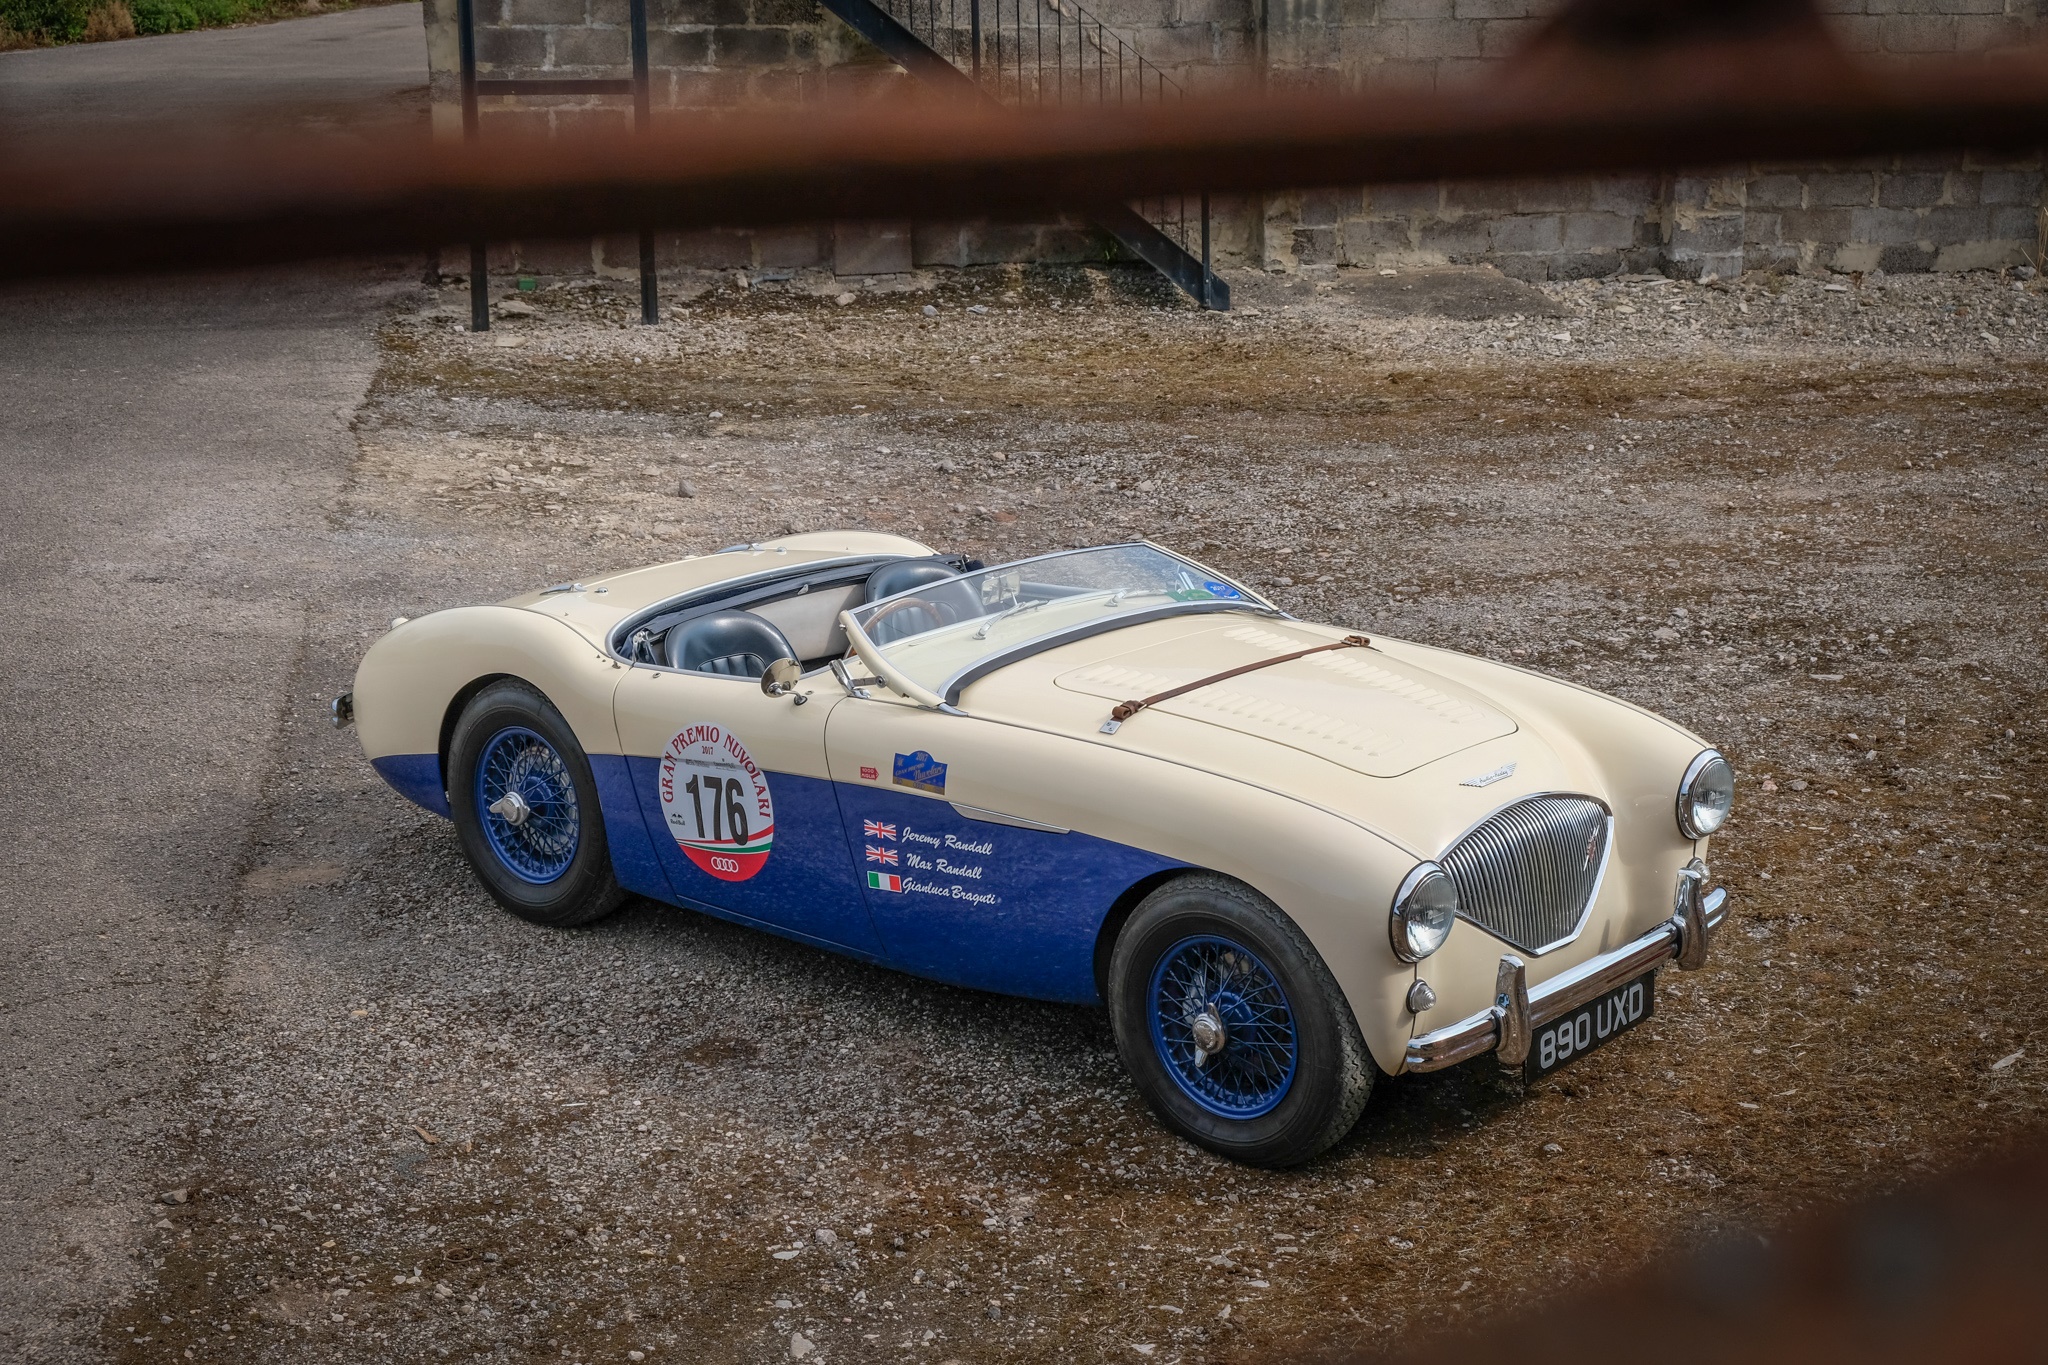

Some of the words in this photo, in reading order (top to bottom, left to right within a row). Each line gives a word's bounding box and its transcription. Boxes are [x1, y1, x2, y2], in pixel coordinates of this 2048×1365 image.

[701, 746, 714, 755] 2017
[661, 751, 678, 803] GRAN
[671, 725, 720, 755] PREMIO
[723, 734, 771, 818] NUVOLARI
[686, 774, 749, 846] 176
[902, 826, 941, 849] Jeremy
[944, 834, 993, 855] Randall
[906, 853, 933, 870] Max
[936, 858, 983, 879] Randall
[902, 877, 950, 894] Gianluca
[951, 885, 996, 906] Braguti
[1540, 1012, 1591, 1070] 890
[1596, 983, 1644, 1039] UXD
